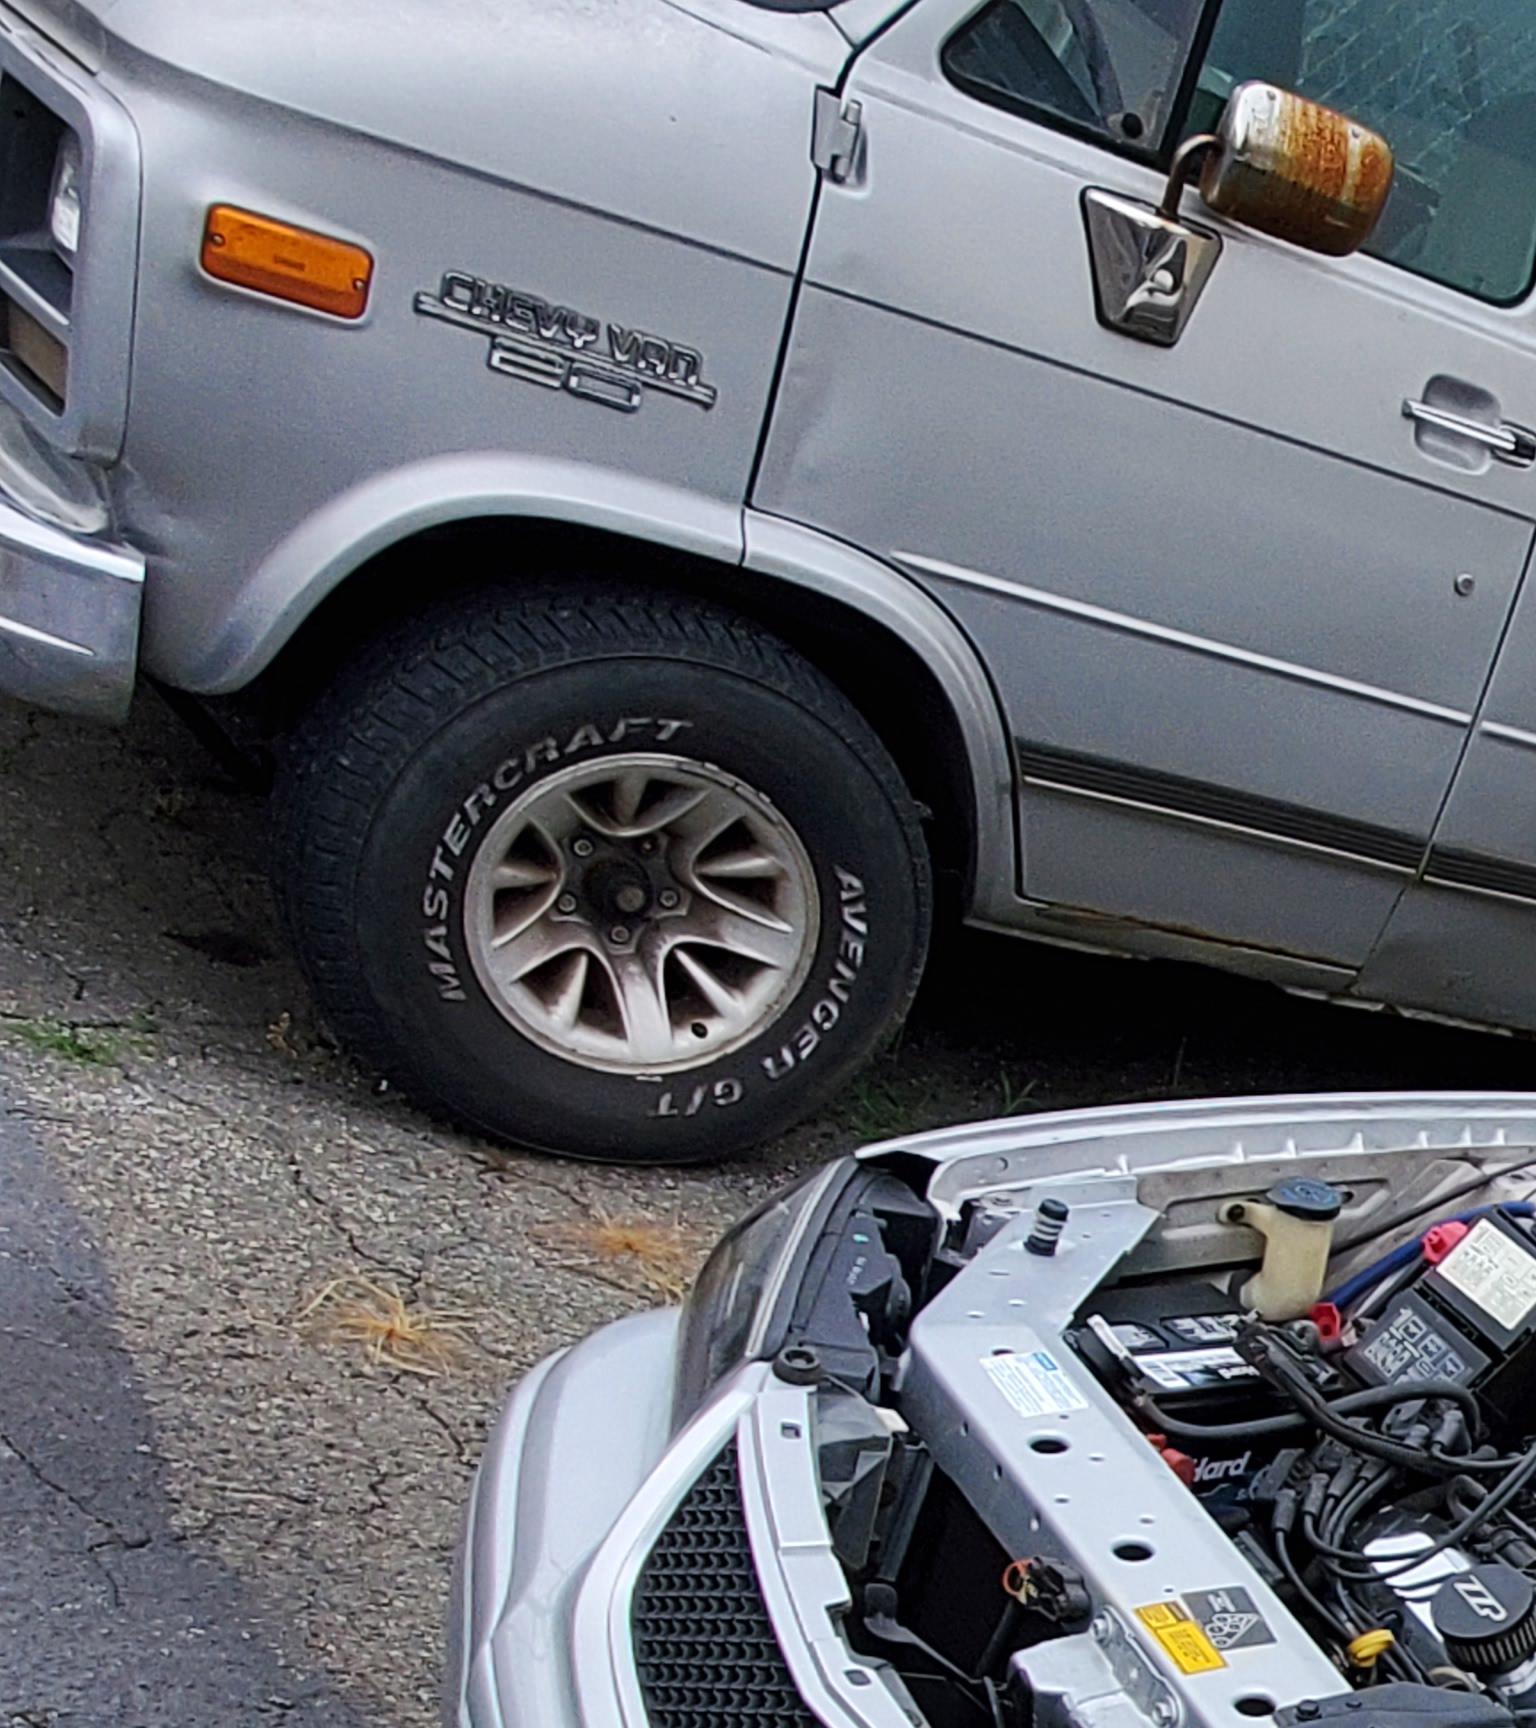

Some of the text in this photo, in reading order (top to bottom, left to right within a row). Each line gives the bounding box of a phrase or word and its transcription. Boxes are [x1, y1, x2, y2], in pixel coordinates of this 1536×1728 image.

[440, 268, 703, 387] CHEVY VAN
[486, 336, 643, 413] 20
[422, 717, 694, 1002] MASTERCRAFT
[760, 863, 868, 1080] AVENGER
